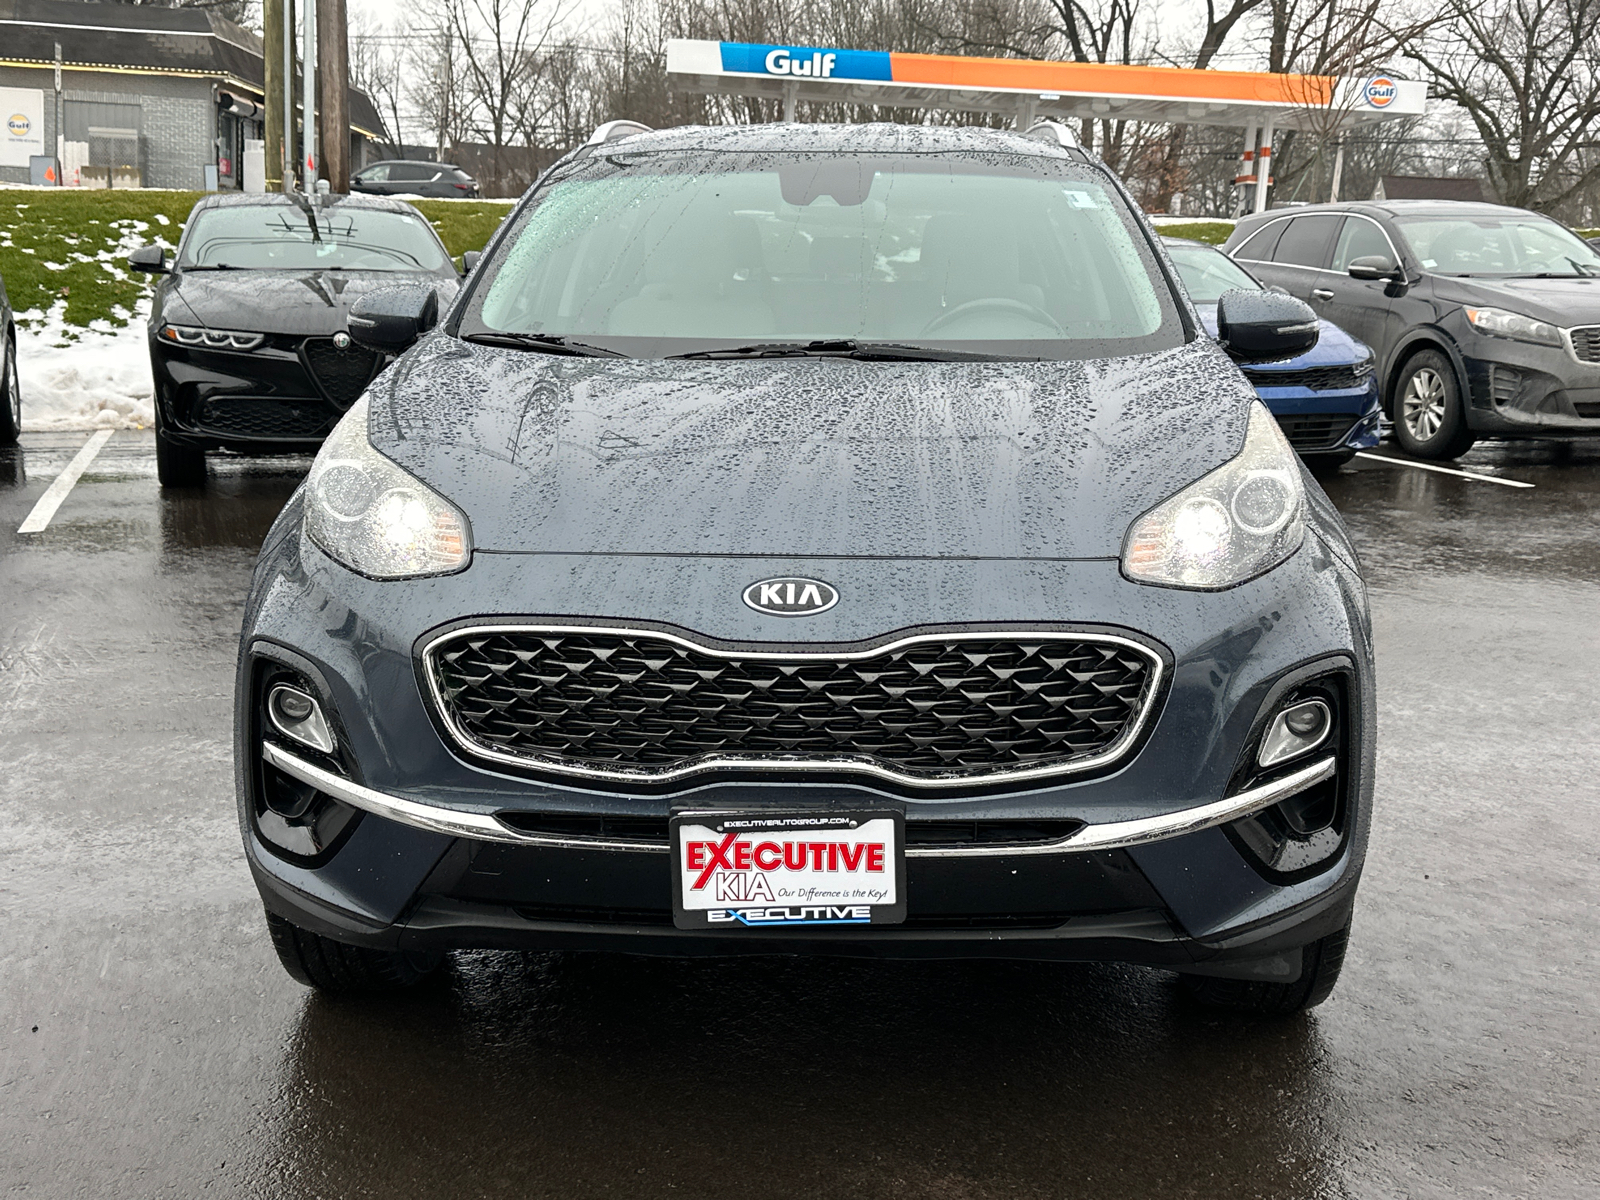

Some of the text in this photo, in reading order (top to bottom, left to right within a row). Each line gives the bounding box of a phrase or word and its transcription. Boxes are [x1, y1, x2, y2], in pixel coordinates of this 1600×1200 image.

[765, 49, 836, 77] Gulf
[1368, 86, 1395, 97] Gulf
[8, 121, 30, 130] Gulf
[760, 583, 823, 606] KIA
[723, 817, 850, 829] EXECUTIVEAUTOGROUP.COM
[686, 832, 885, 891] EXECUTIVE
[716, 872, 776, 902] KIA
[778, 887, 888, 902] Our Difference is the Key!
[707, 905, 871, 926] EXECUTIVE
